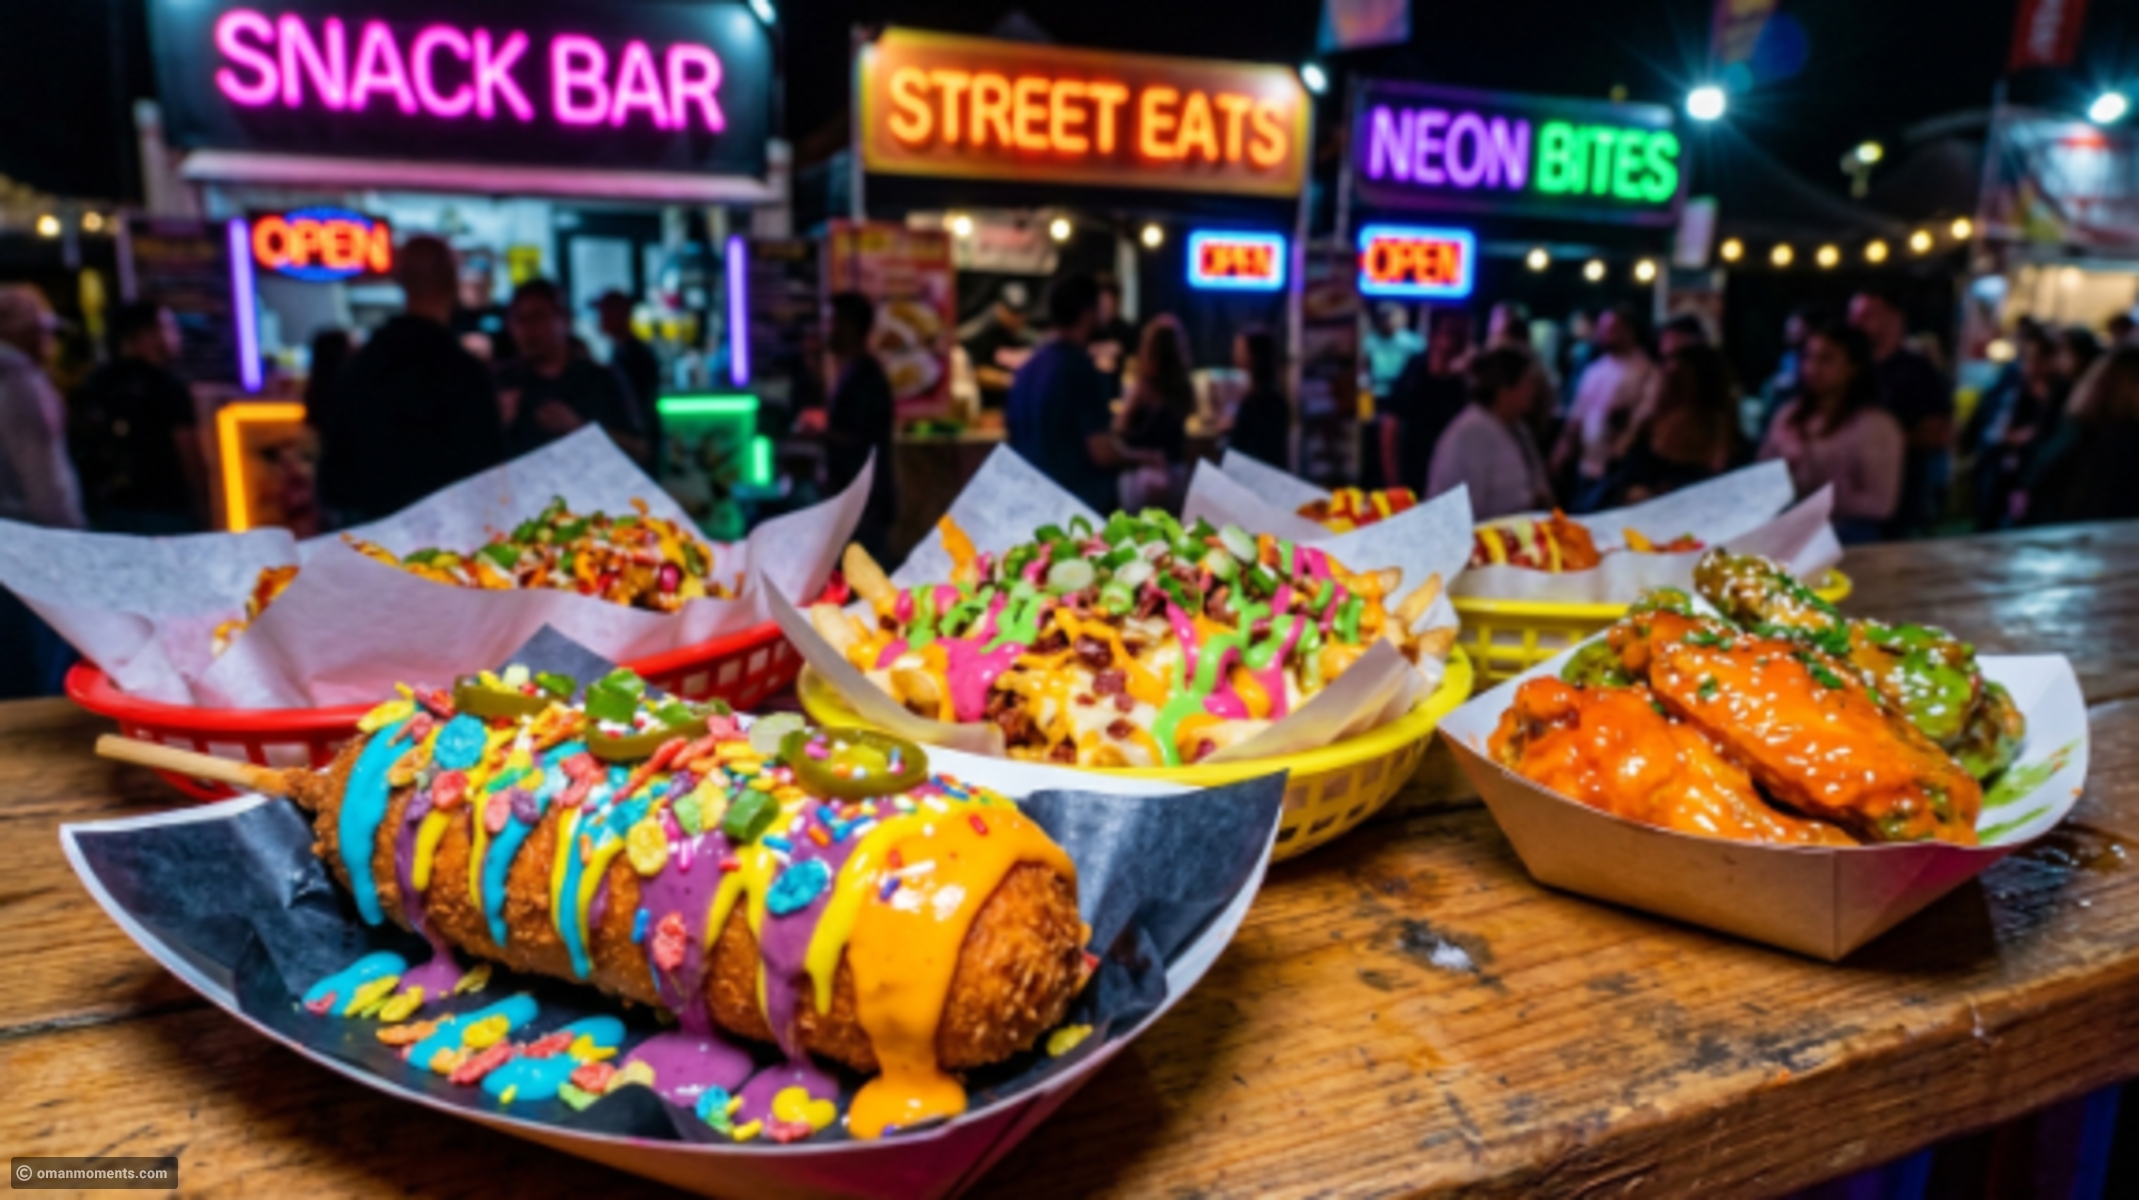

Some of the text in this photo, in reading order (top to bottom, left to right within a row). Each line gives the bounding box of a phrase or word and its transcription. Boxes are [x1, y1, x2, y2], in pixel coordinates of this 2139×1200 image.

[214, 8, 726, 133] SNACK BAR
[887, 67, 1288, 167] STREET EATS
[1368, 106, 1681, 203] NEON BITES
[252, 215, 391, 273] OPEN
[1200, 245, 1272, 277] OPEN
[1361, 238, 1461, 284] OPEN
